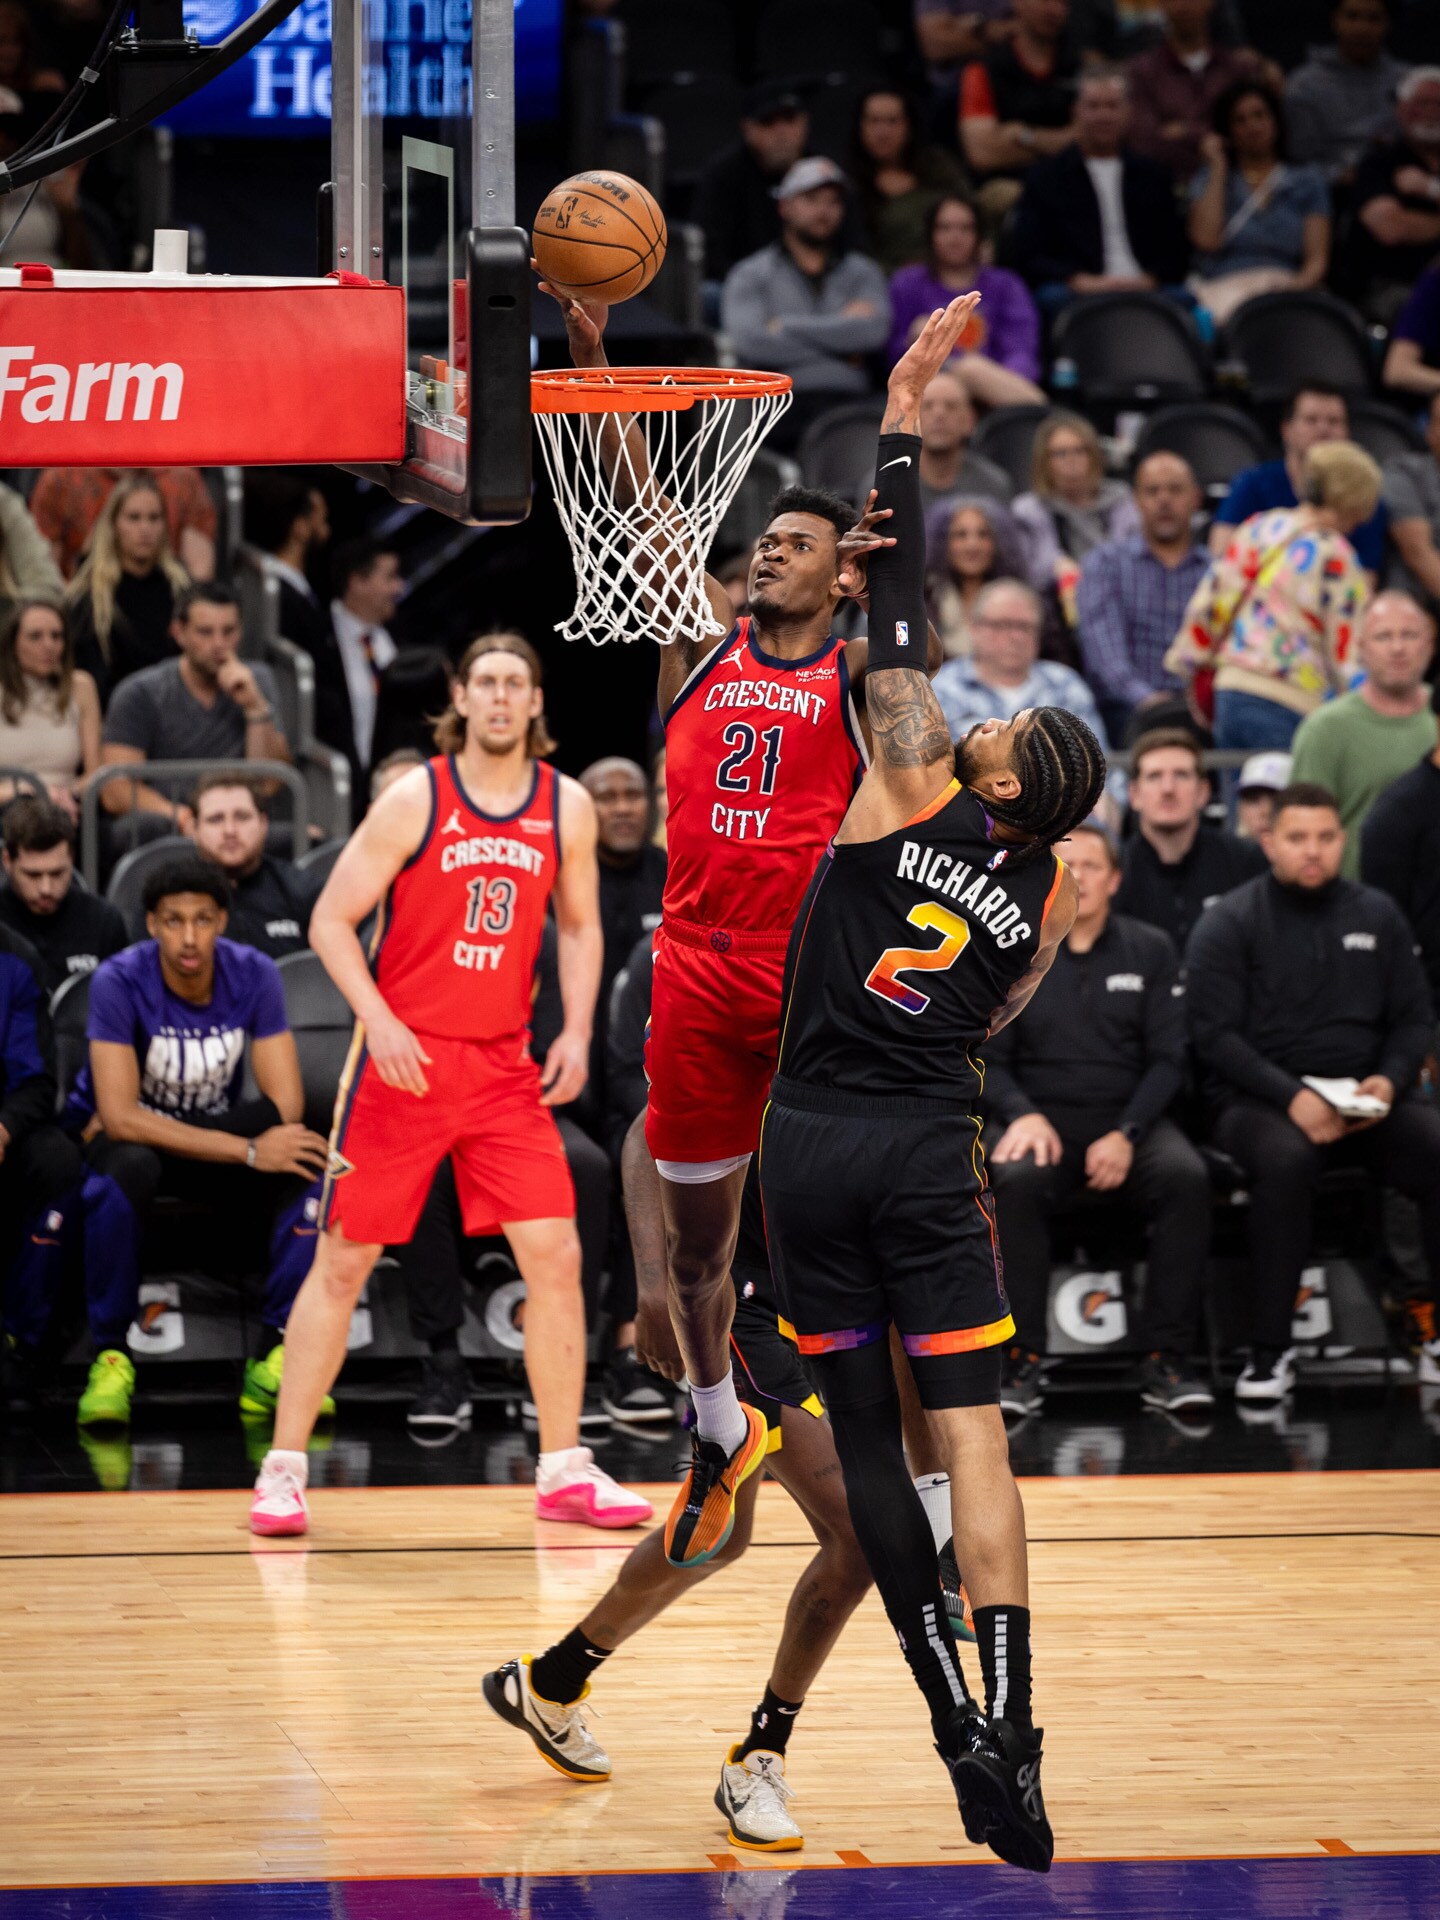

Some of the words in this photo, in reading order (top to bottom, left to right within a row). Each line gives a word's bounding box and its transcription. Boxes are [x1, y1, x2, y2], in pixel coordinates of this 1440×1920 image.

[0, 345, 185, 424] Farm
[703, 680, 826, 725] CRESCENT
[716, 721, 784, 796] 21
[711, 802, 771, 840] CITY
[441, 836, 545, 877] CRESCENT
[464, 876, 518, 935] 13
[896, 840, 1032, 949] RICHARDS
[453, 940, 506, 971] CITY
[864, 901, 971, 1015] 2
[1054, 1270, 1128, 1344] G
